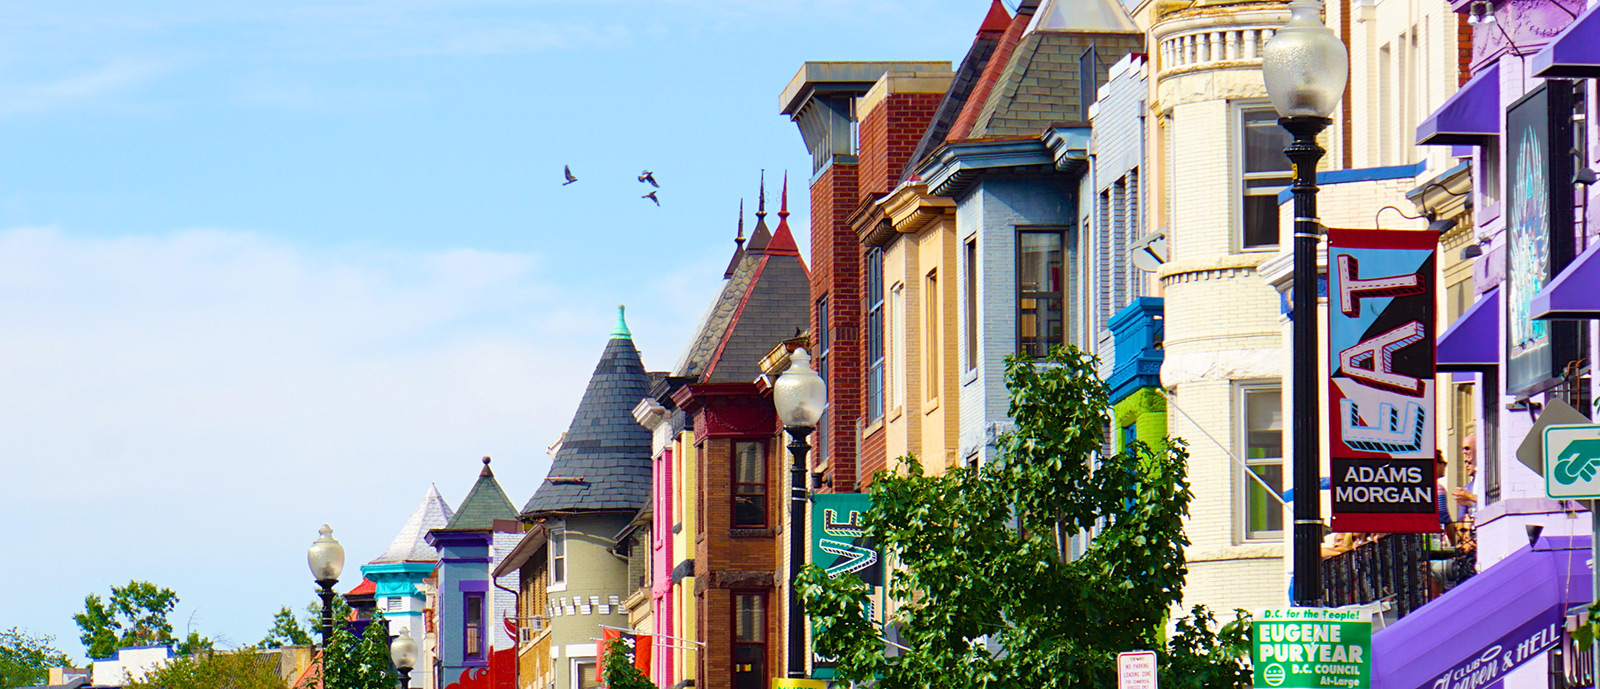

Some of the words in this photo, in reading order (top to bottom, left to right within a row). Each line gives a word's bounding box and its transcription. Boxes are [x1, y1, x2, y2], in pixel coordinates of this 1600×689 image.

[1337, 253, 1426, 453] EAT
[1344, 466, 1423, 483] ADAMS
[1335, 486, 1432, 504] MORGAN
[1264, 609, 1283, 619] D.C.
[1286, 609, 1301, 618] for
[1303, 609, 1320, 619] the
[1322, 609, 1360, 621] People!
[1259, 624, 1341, 643] EUGENE
[1259, 644, 1364, 663] PURYEAR
[1502, 650, 1514, 672] &
[1516, 623, 1560, 663] HELL
[1292, 664, 1312, 674] D.C.
[1314, 664, 1360, 675] COUNCIL
[1454, 660, 1482, 681] CLUB
[1320, 676, 1360, 689] At-Large
